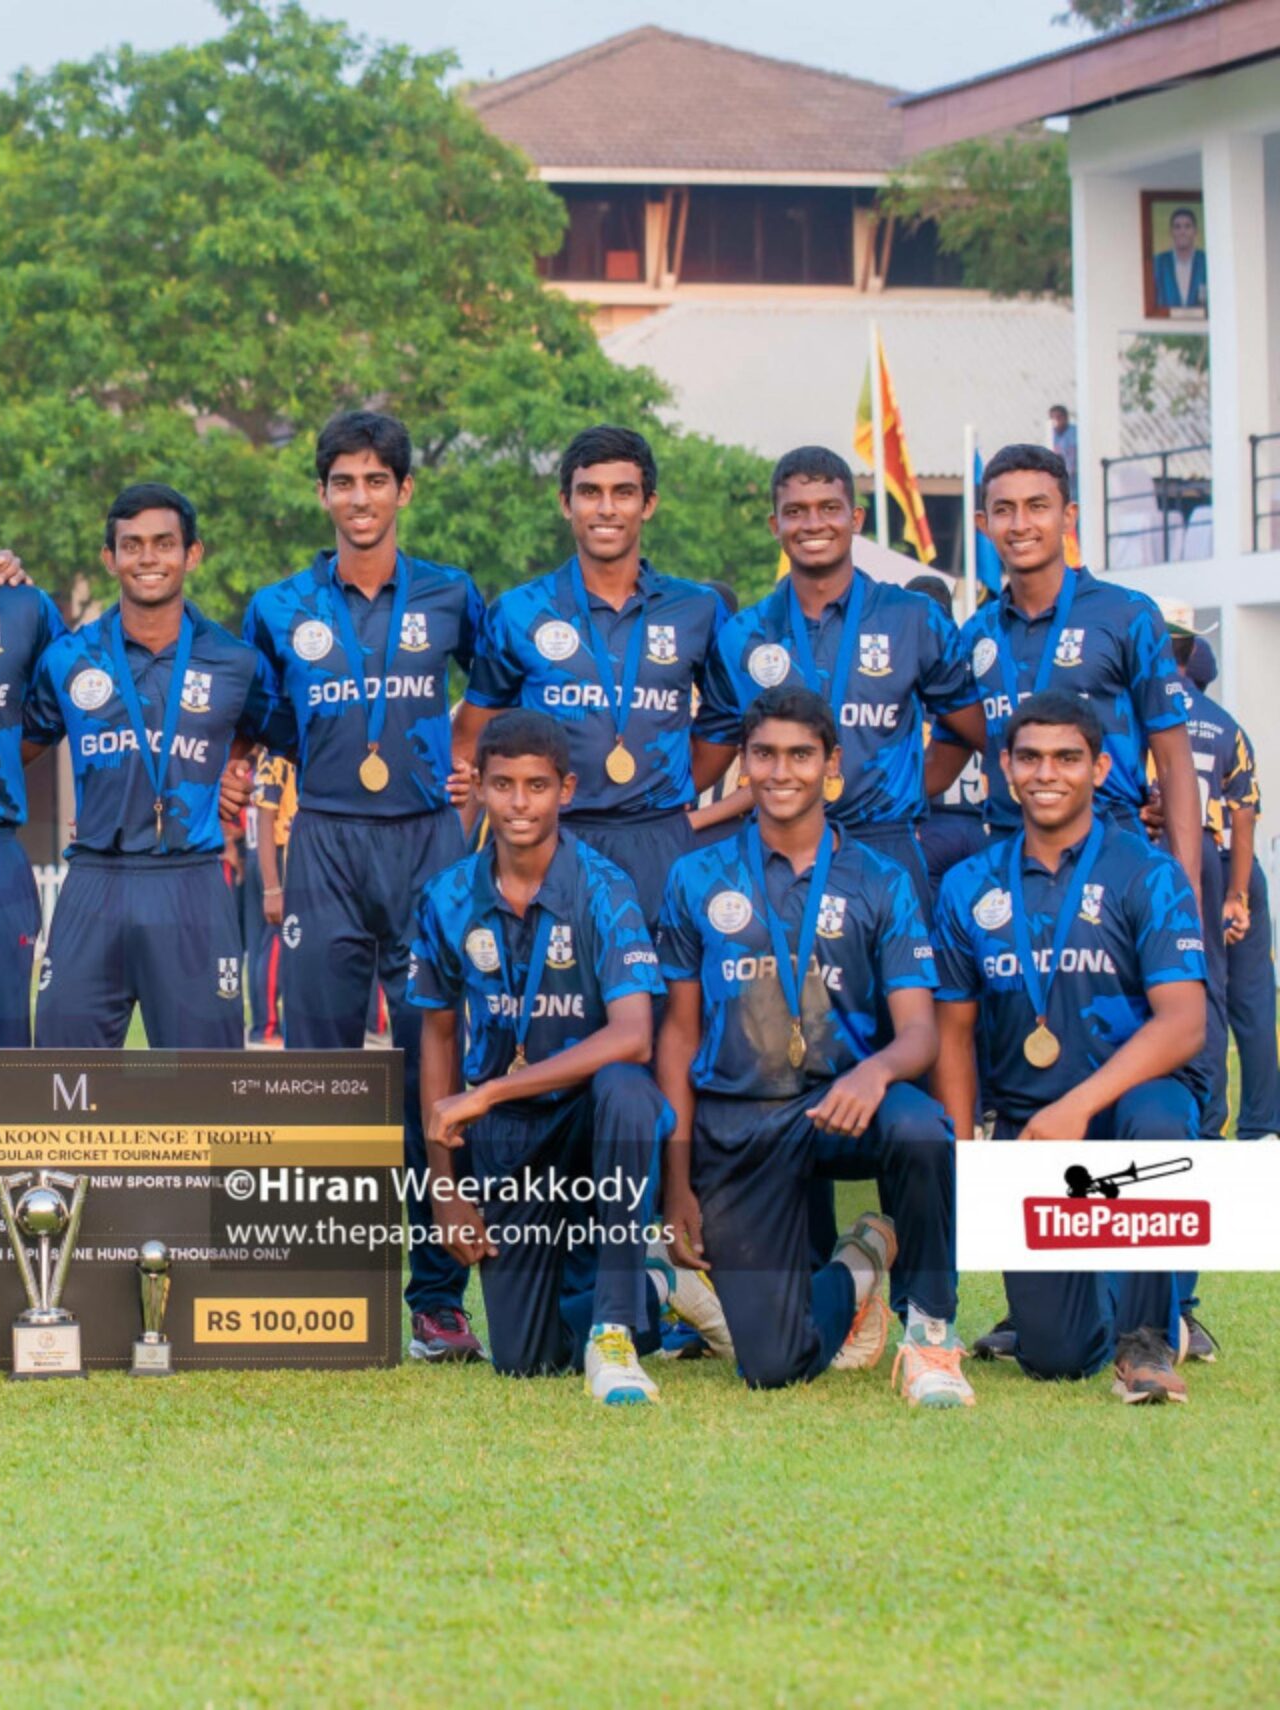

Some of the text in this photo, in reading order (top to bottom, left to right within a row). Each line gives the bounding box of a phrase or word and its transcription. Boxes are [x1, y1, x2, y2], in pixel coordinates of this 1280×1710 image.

[265, 1079, 326, 1095] MARCH
[330, 1079, 369, 1095] 2024
[65, 1130, 188, 1145] CHALLENGE
[192, 1130, 275, 1145] TROPHY
[47, 1149, 108, 1161] CRICKET
[111, 1149, 210, 1161] TOURNAMENT
[90, 1175, 124, 1188] NEW
[126, 1175, 182, 1188] SPORTS
[252, 1248, 291, 1261] ONLY
[207, 1309, 355, 1335] RS 100,000
